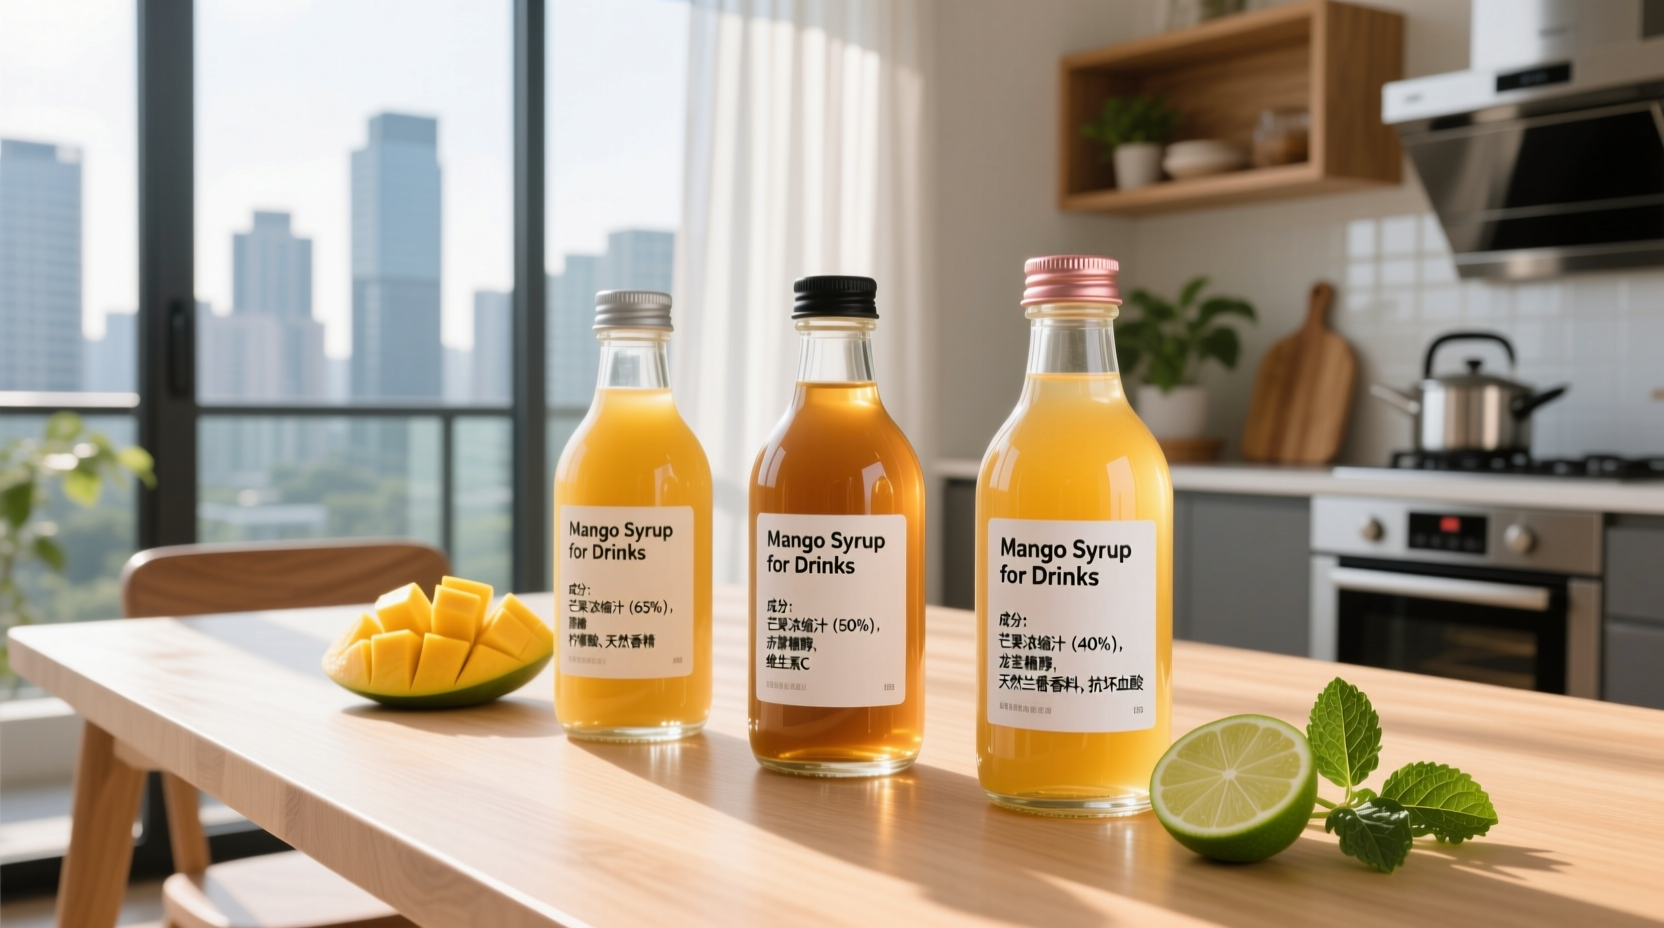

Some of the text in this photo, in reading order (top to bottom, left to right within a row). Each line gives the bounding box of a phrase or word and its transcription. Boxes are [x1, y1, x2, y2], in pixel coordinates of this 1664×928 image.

[569, 520, 674, 543] Mango Syrup
[767, 529, 886, 555] Mango Syrup
[568, 542, 647, 561] for Drinks
[1000, 536, 1132, 565] Mango Syrup
[766, 554, 855, 575] for Drinks
[999, 564, 1100, 587] for Drinks
